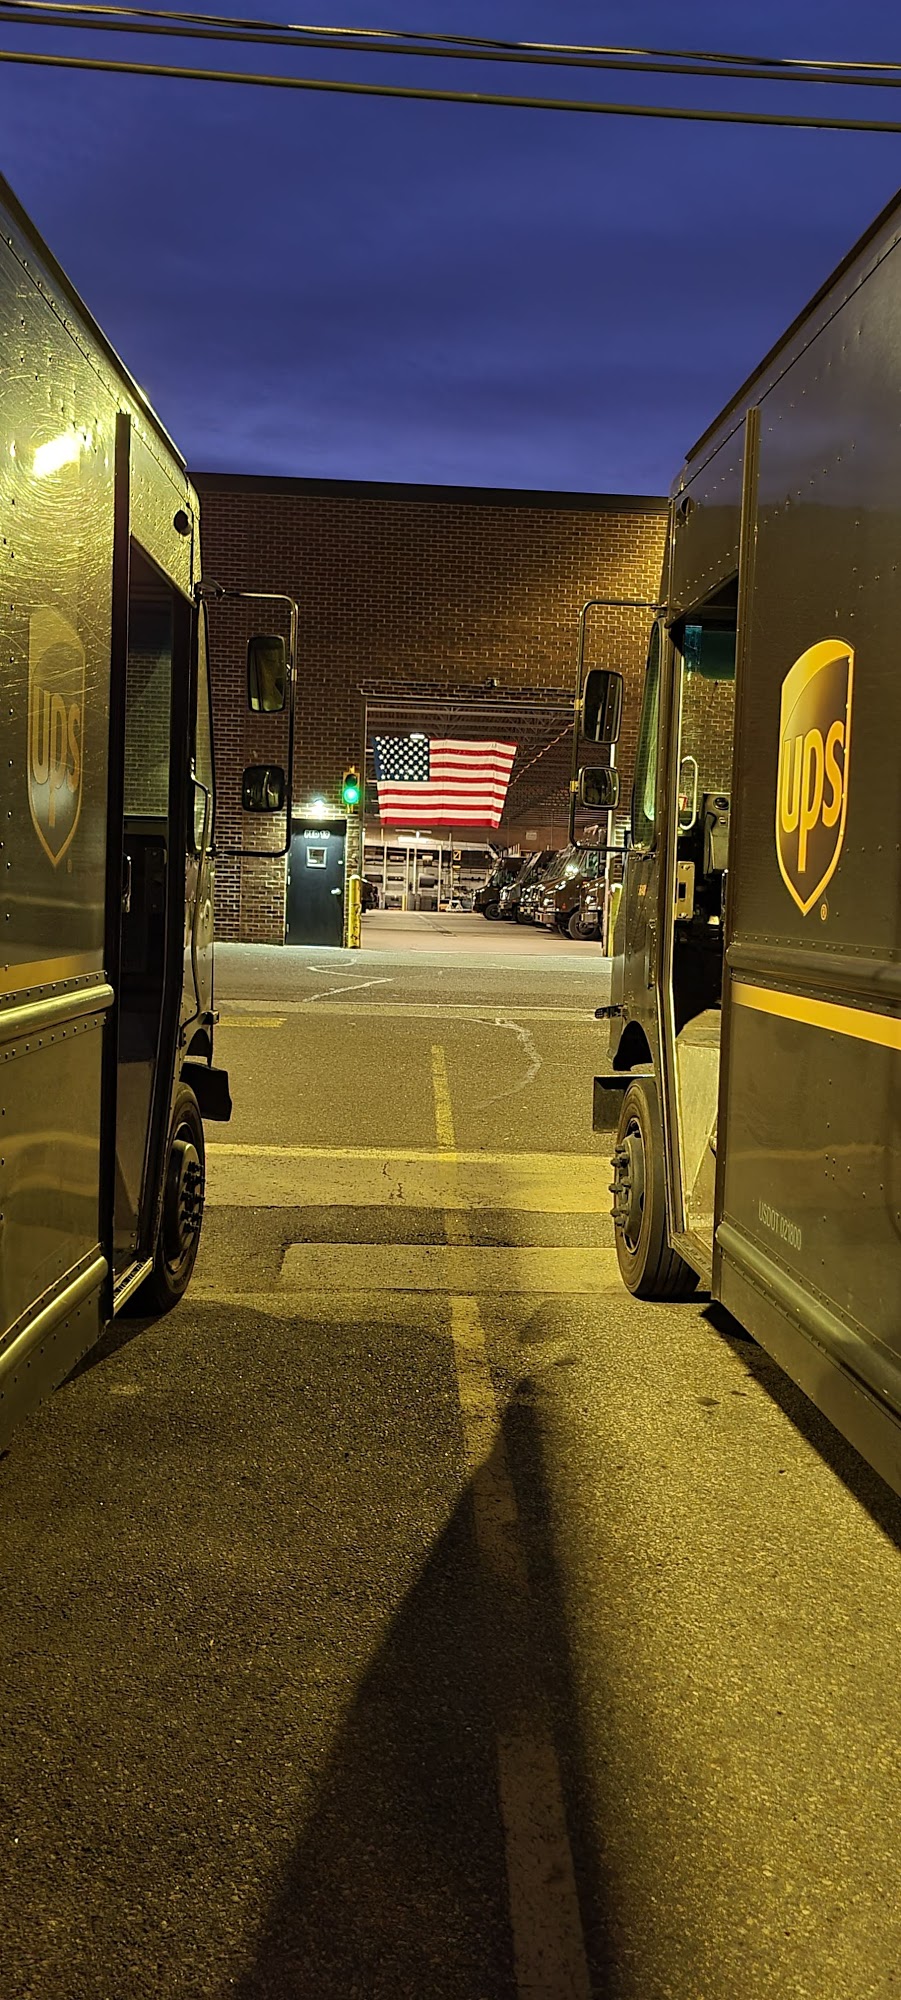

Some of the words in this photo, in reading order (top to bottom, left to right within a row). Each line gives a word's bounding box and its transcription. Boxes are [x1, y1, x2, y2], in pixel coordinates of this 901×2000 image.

[31, 684, 81, 828] ups
[781, 720, 845, 873] ups
[758, 1200, 780, 1234] USDOT
